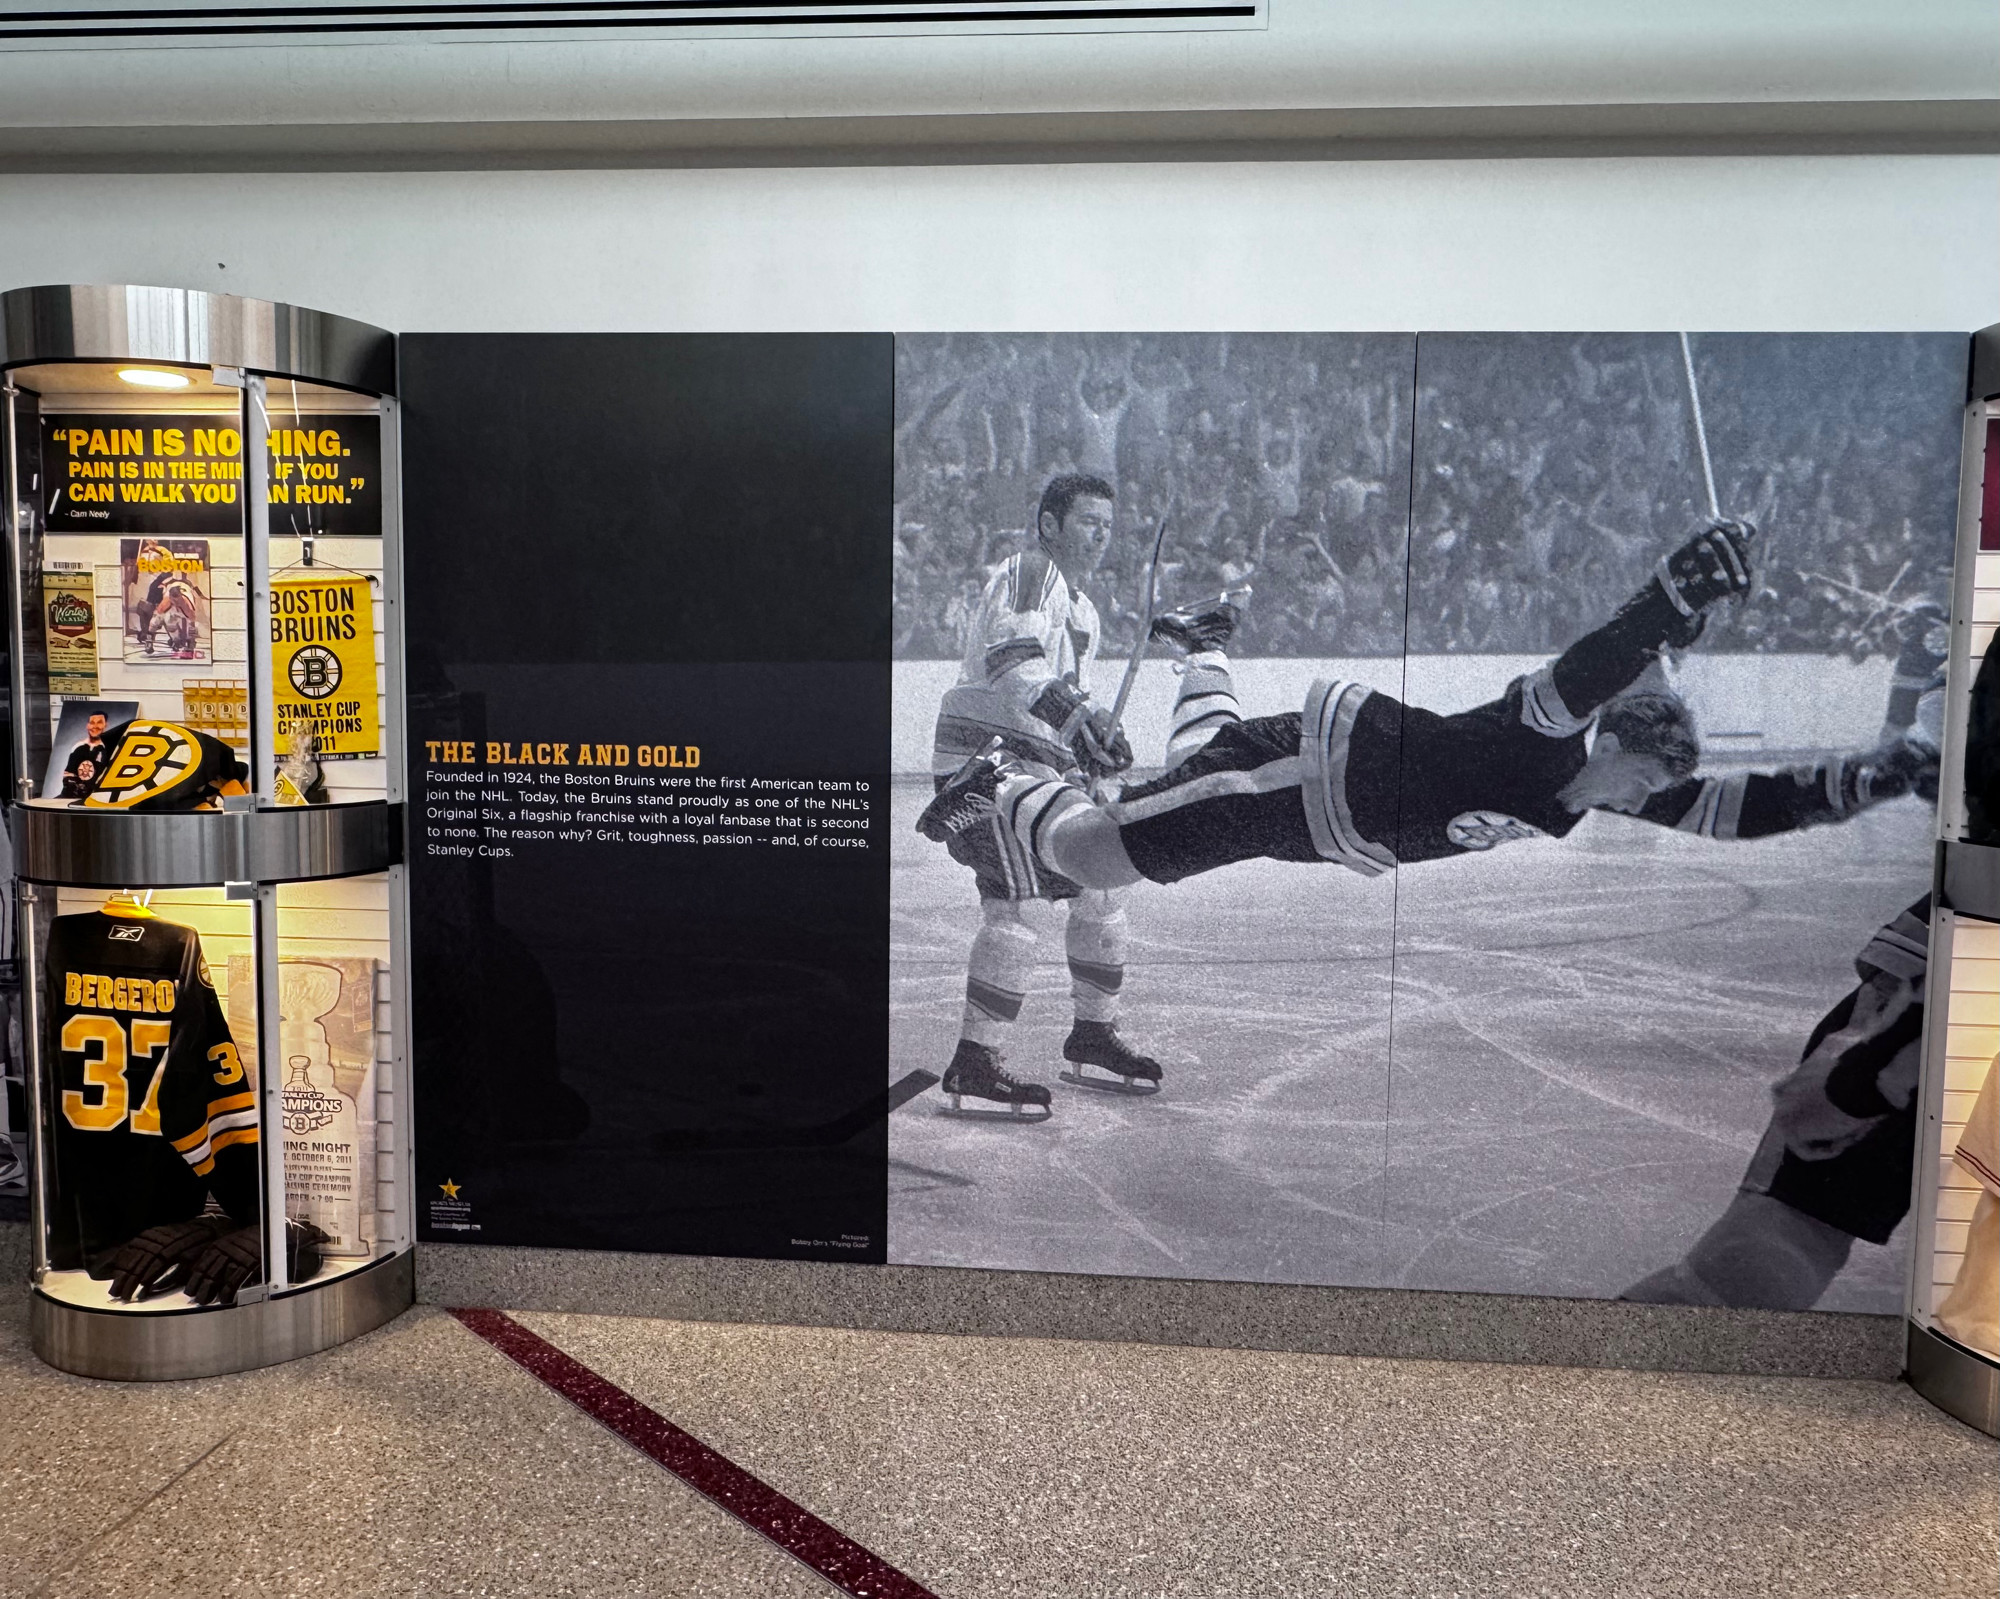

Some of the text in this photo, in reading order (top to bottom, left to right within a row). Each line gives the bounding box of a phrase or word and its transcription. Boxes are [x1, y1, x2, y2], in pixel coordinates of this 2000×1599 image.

[53, 428, 351, 457] “PAIN IS NOHING.
[68, 462, 114, 479] PAIN
[120, 462, 139, 479] IS
[144, 462, 165, 479] IN
[168, 462, 206, 479] THE
[275, 463, 294, 479] IF
[298, 463, 338, 479] YOU
[68, 483, 114, 503] CAN
[120, 484, 185, 503] WALK
[189, 484, 236, 503] YOU
[70, 510, 88, 518] Cam
[89, 510, 110, 519] Neely
[138, 559, 204, 573] BOSTON
[270, 587, 354, 614] BOSTON
[271, 614, 356, 643] BRUINS
[278, 702, 360, 719] STANLEY CUP
[425, 741, 700, 768] THE BLACK AND GOLD
[426, 770, 870, 792] Founded in 1924, the Boston Bruins were the first American team to
[426, 788, 870, 810] join the NHL. Today, the Bruins stand proudly as one of the NHL's
[426, 807, 870, 829] Original Six, a flagship franchise with a loyal fanbase that is second
[427, 826, 440, 837] to
[444, 828, 480, 838] none.
[484, 827, 508, 838] The
[512, 829, 554, 840] reason
[558, 829, 592, 842] why?
[596, 830, 624, 842] Grit,
[628, 831, 699, 844] toughness,
[703, 833, 752, 845] passion
[772, 834, 800, 846] and,
[804, 834, 818, 846] of
[822, 837, 870, 848] course,
[427, 844, 514, 858] Stanley Cups.
[65, 972, 180, 1013] BERGERO
[61, 1014, 172, 1136] 37
[207, 1042, 244, 1086] 3
[282, 1098, 342, 1112] AMPIONS
[292, 1152, 324, 1162] OCTOBER
[327, 1155, 334, 1164] 6,
[336, 1156, 352, 1164] 2011
[312, 1142, 351, 1154] NIGHT
[312, 1182, 352, 1192] CEREMONY
